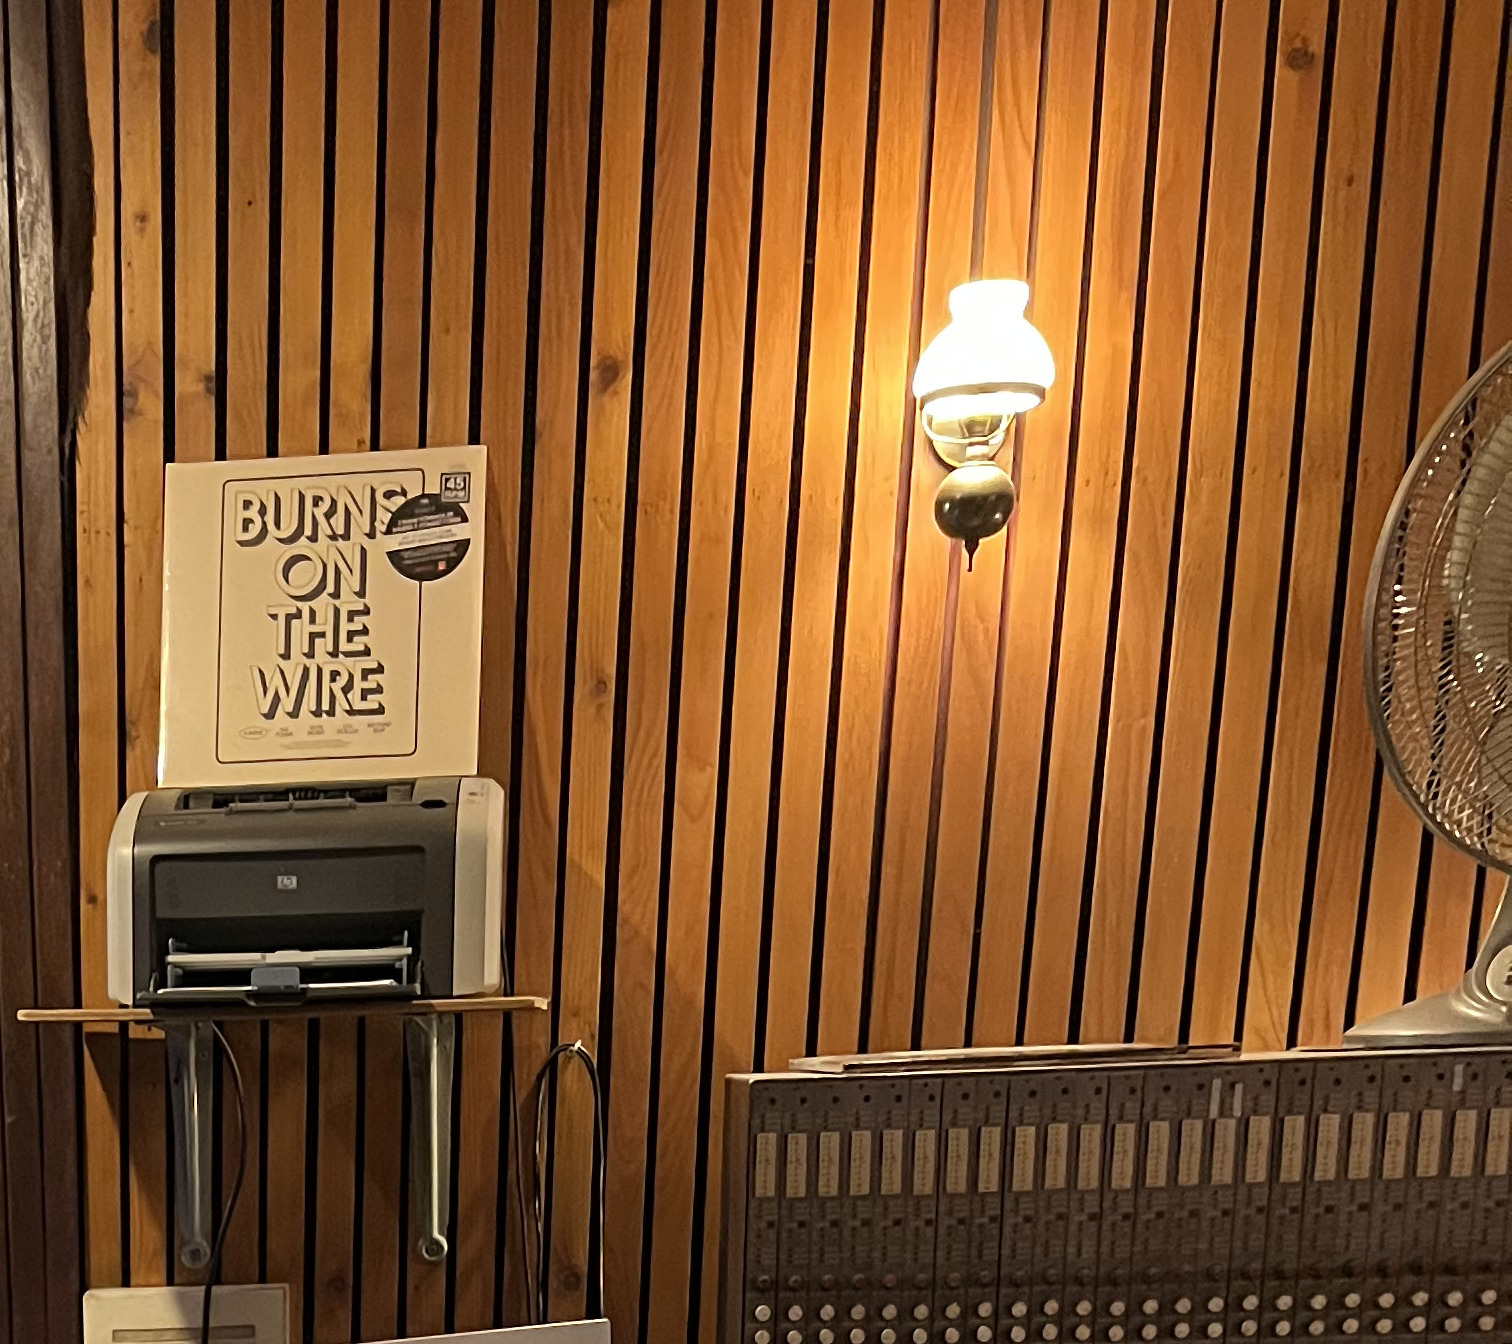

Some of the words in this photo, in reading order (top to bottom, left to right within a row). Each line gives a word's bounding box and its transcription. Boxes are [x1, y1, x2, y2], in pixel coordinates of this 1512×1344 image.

[446, 477, 465, 490] 45
[234, 482, 410, 547] BURNS
[274, 542, 367, 601] ON
[267, 601, 371, 659] THE
[250, 660, 385, 720] WIRE
